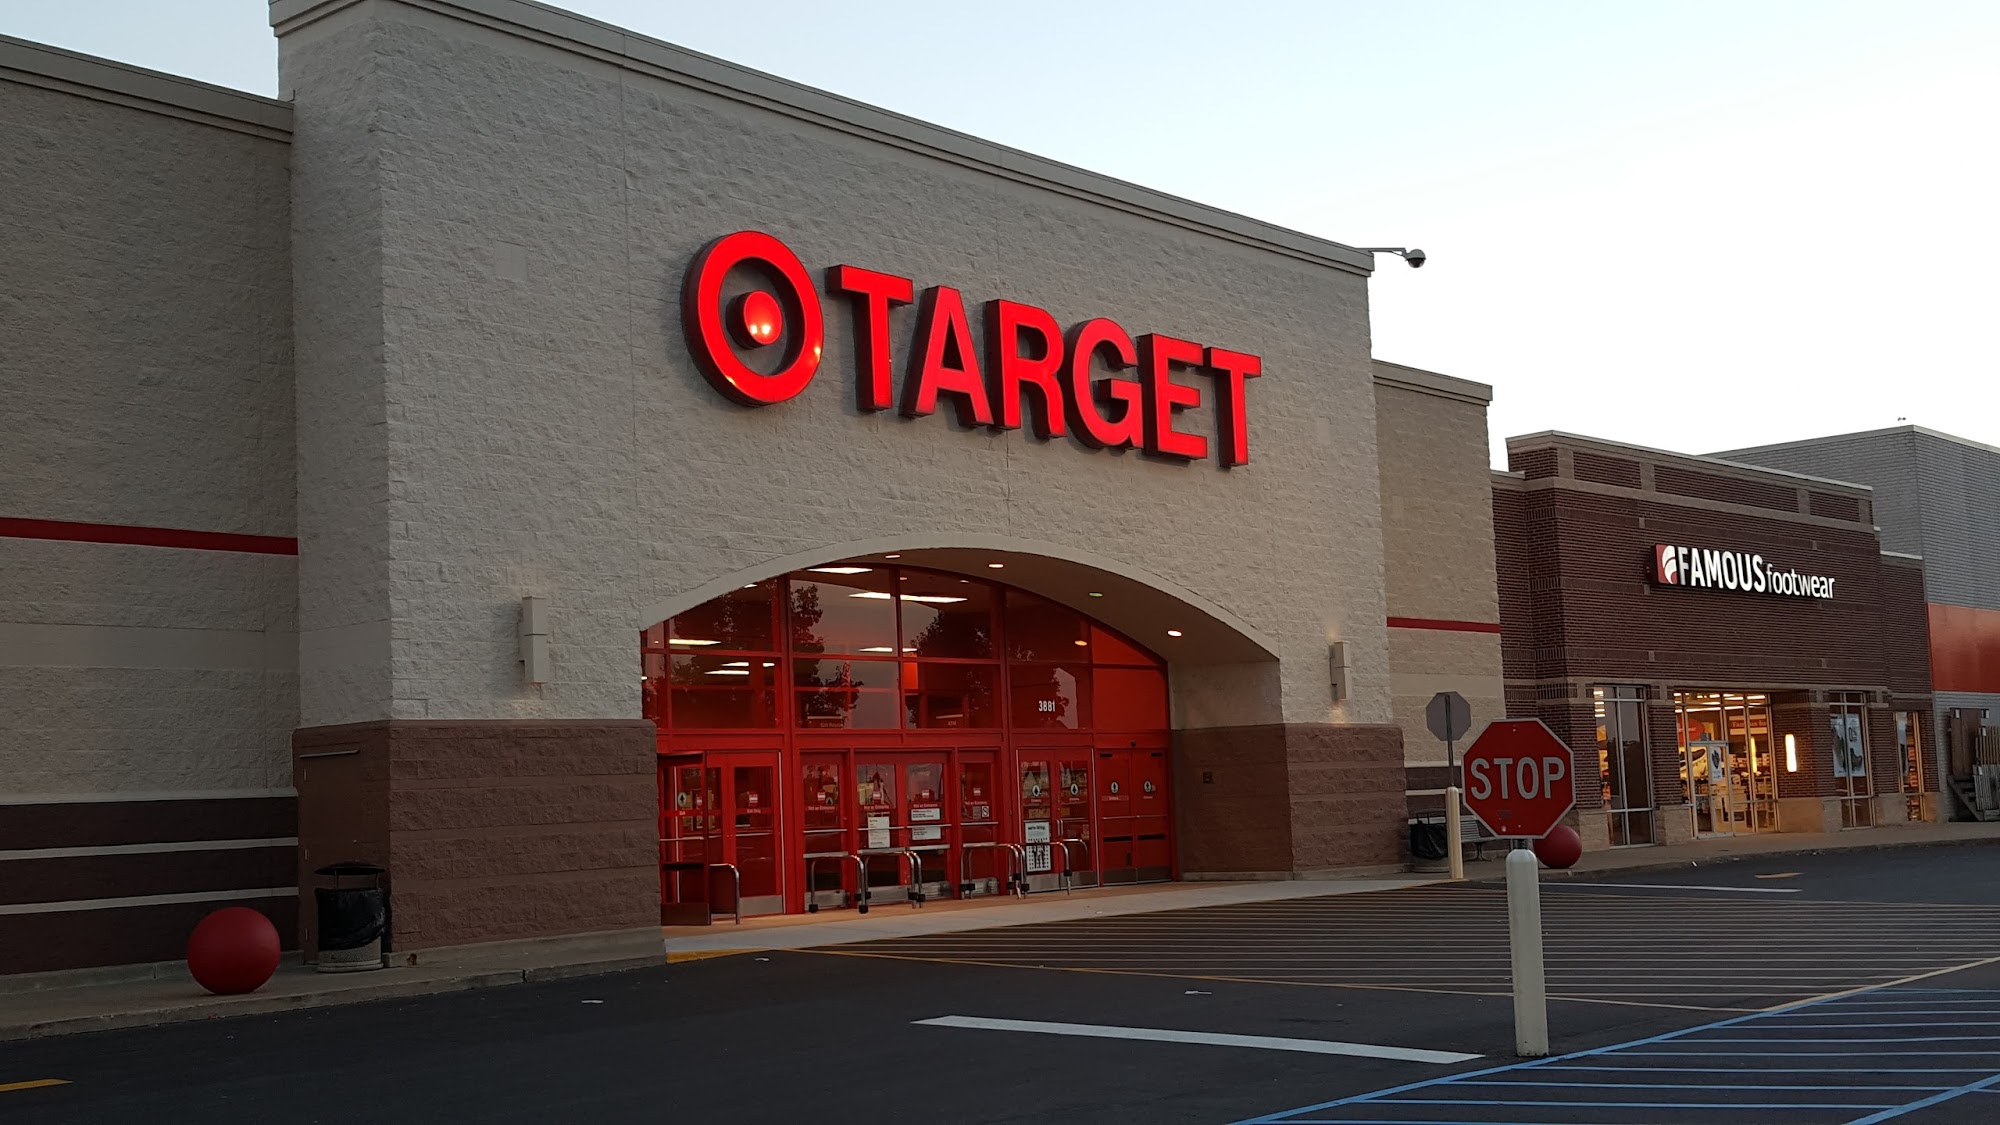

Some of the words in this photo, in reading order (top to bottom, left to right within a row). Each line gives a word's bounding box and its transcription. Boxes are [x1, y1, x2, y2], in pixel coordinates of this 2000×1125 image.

[826, 264, 1261, 468] TARGET
[1677, 546, 1766, 593] FAMOUS
[1765, 563, 1835, 598] footwear
[1038, 700, 1056, 712] 3881
[1470, 757, 1565, 800] STOP
